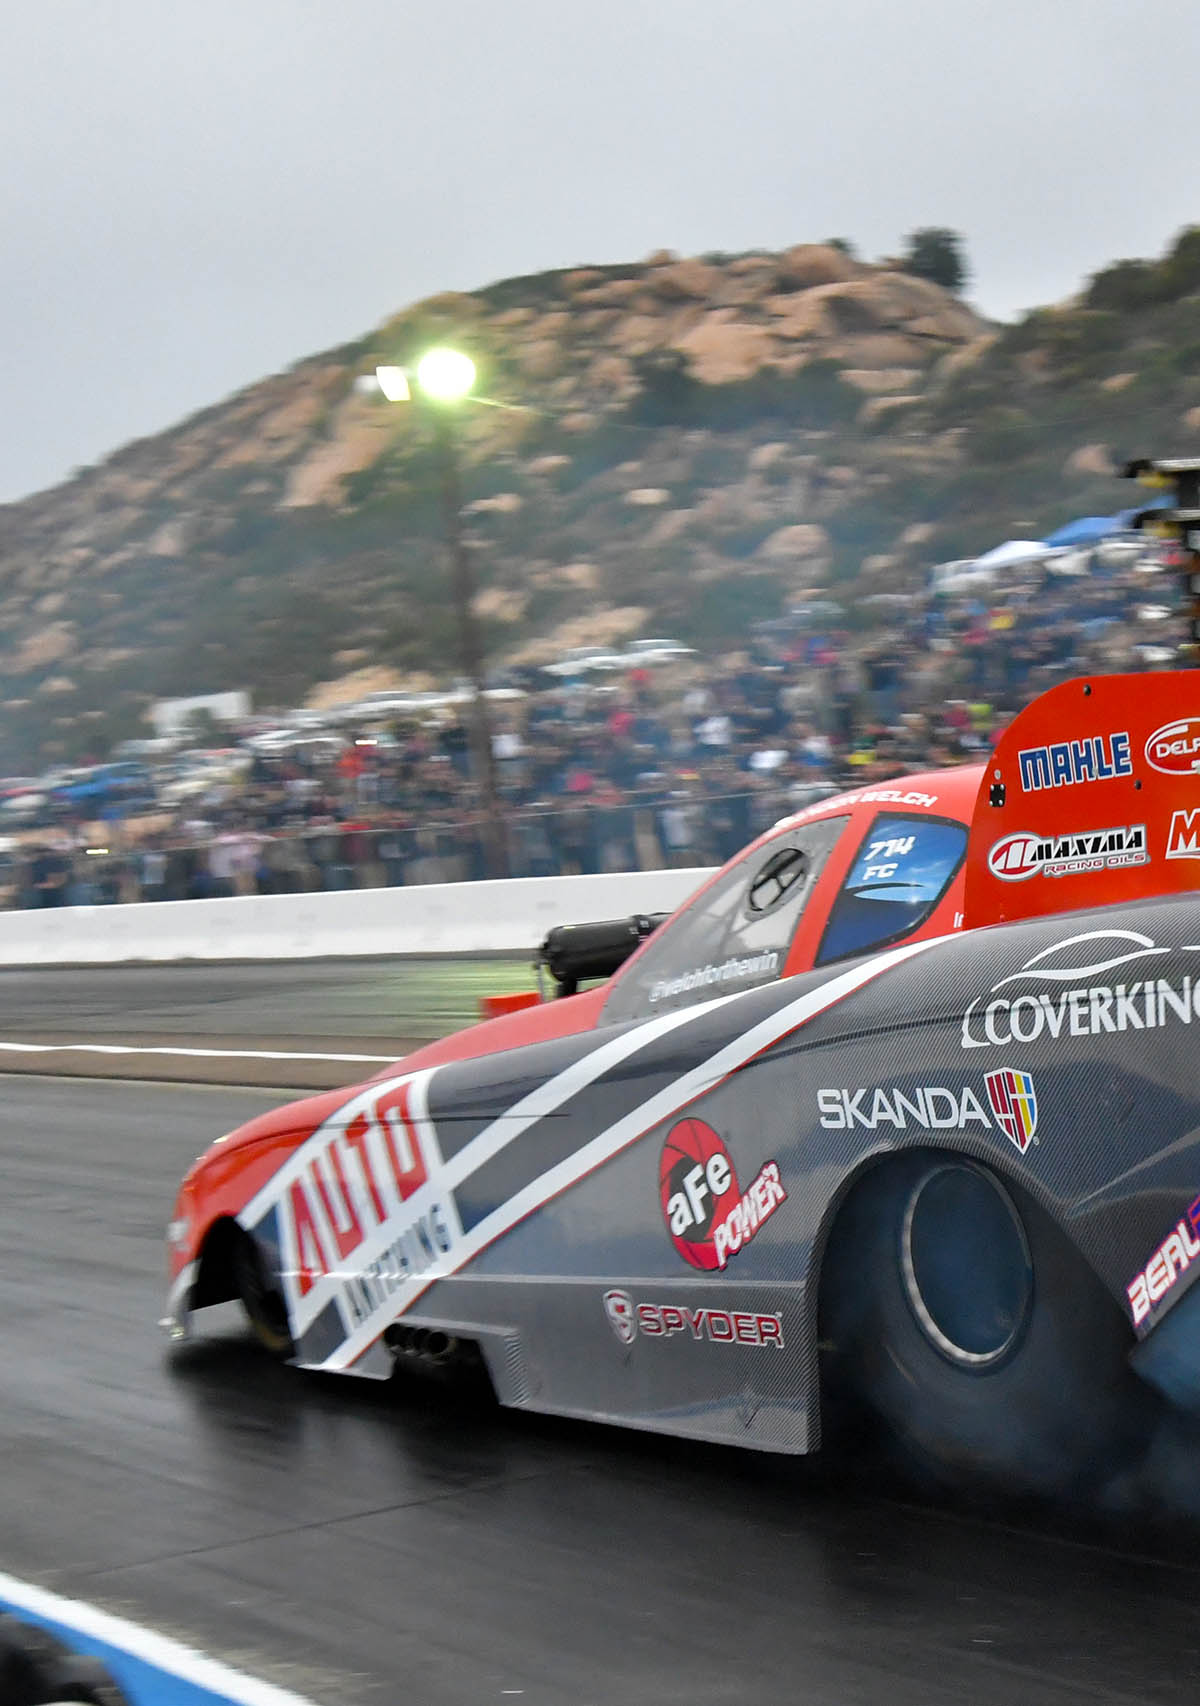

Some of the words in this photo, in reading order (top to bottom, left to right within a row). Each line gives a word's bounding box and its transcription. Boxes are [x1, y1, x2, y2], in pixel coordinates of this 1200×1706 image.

[1018, 732, 1132, 791] MAHLE
[1030, 830, 1144, 862] MAXIMA
[1108, 853, 1145, 866] OILS
[862, 863, 899, 881] FC
[817, 1087, 992, 1129] SKANDA
[287, 1080, 428, 1297] AUTO
[667, 1153, 732, 1236] aFe
[713, 1163, 785, 1267] POWER
[637, 1303, 784, 1348] SPYDER
